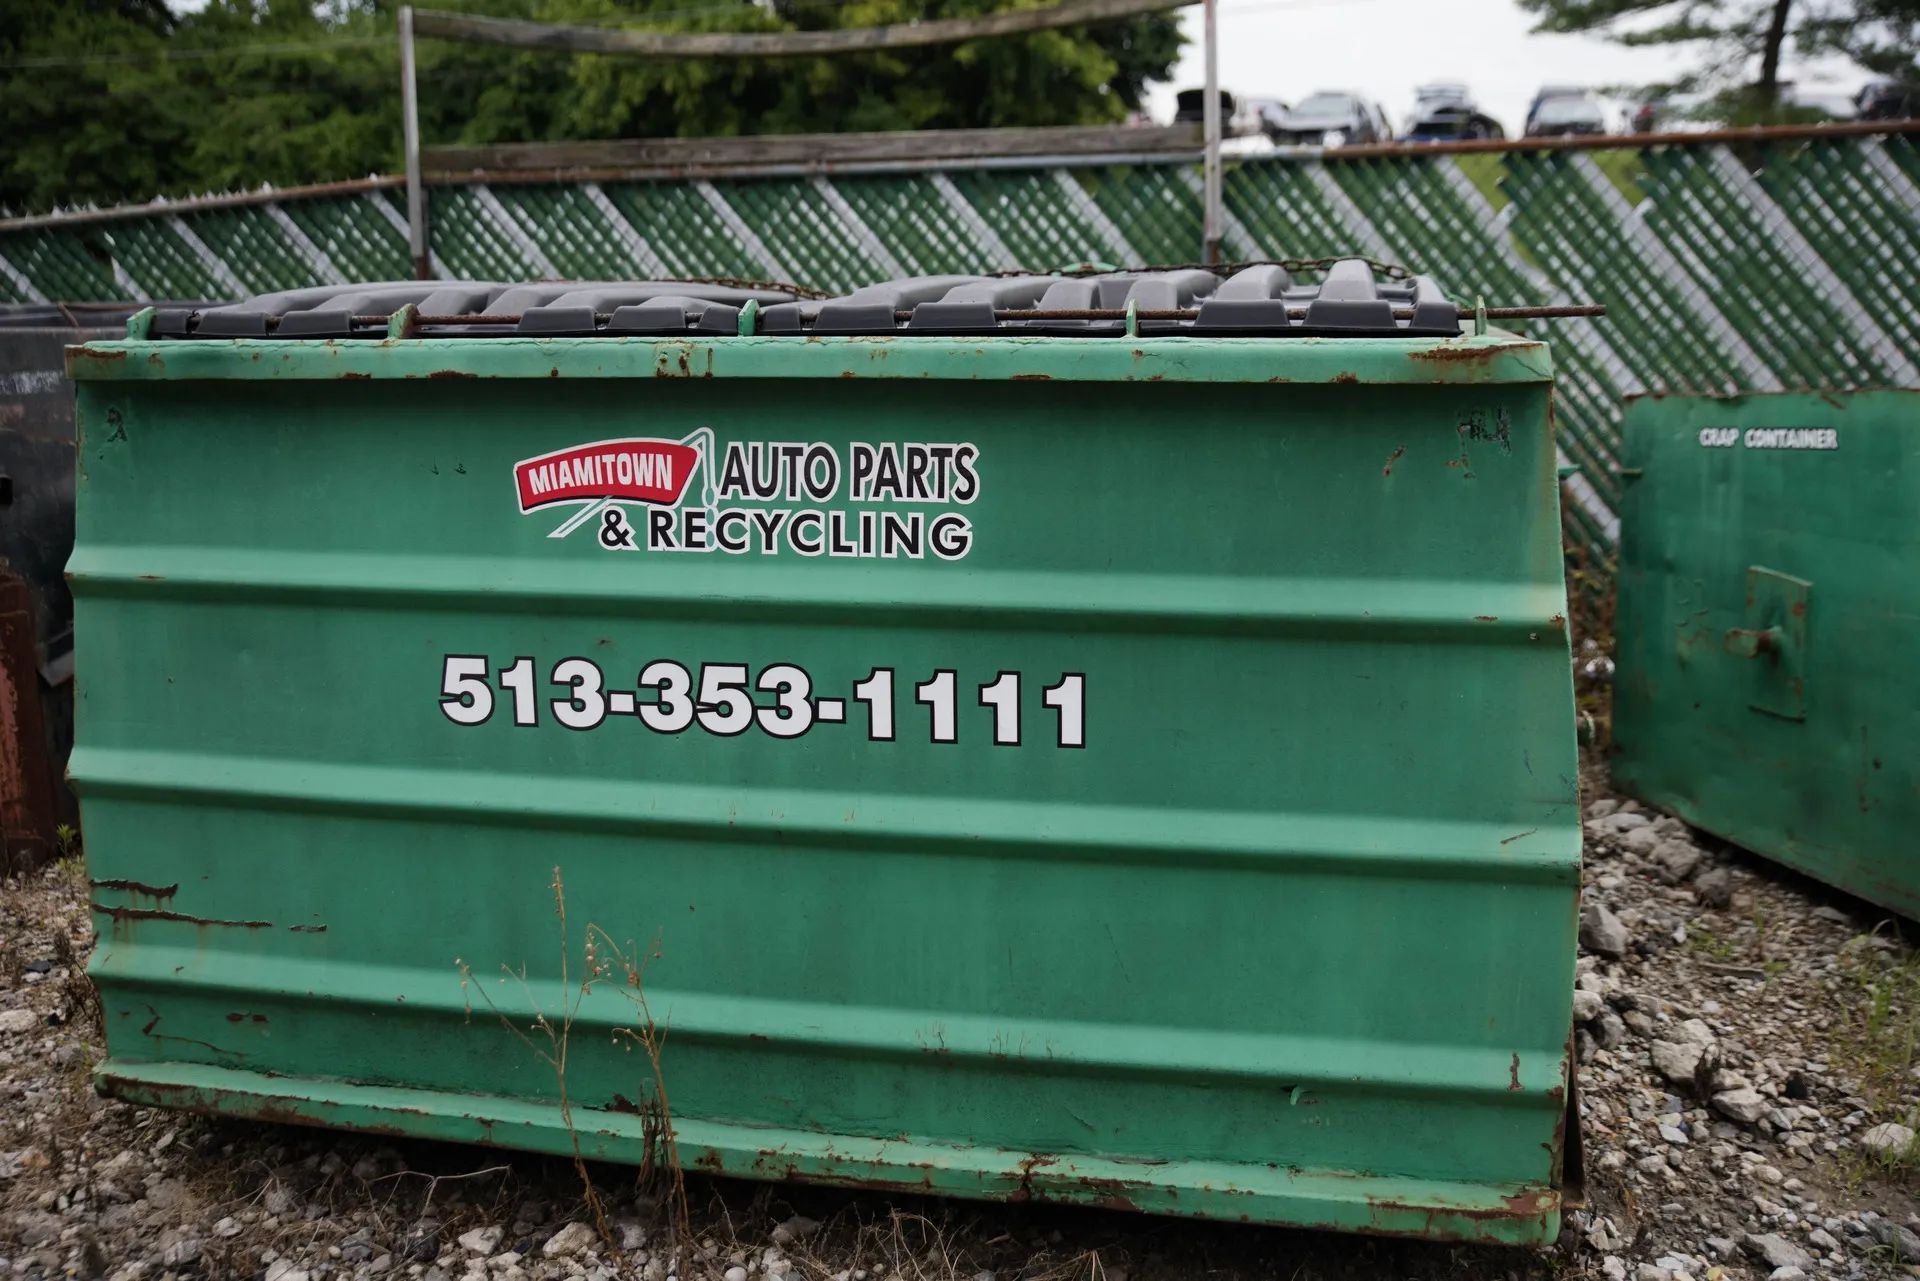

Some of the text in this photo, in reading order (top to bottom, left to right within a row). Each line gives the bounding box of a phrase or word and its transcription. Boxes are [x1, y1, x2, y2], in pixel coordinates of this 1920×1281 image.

[1744, 428, 1838, 449] CONTAINER
[527, 452, 673, 496] MIAMITOWN
[719, 444, 978, 501] AUTO PARTS
[600, 509, 972, 557] & RECYCLING
[439, 653, 1087, 749] 513-353-1111
